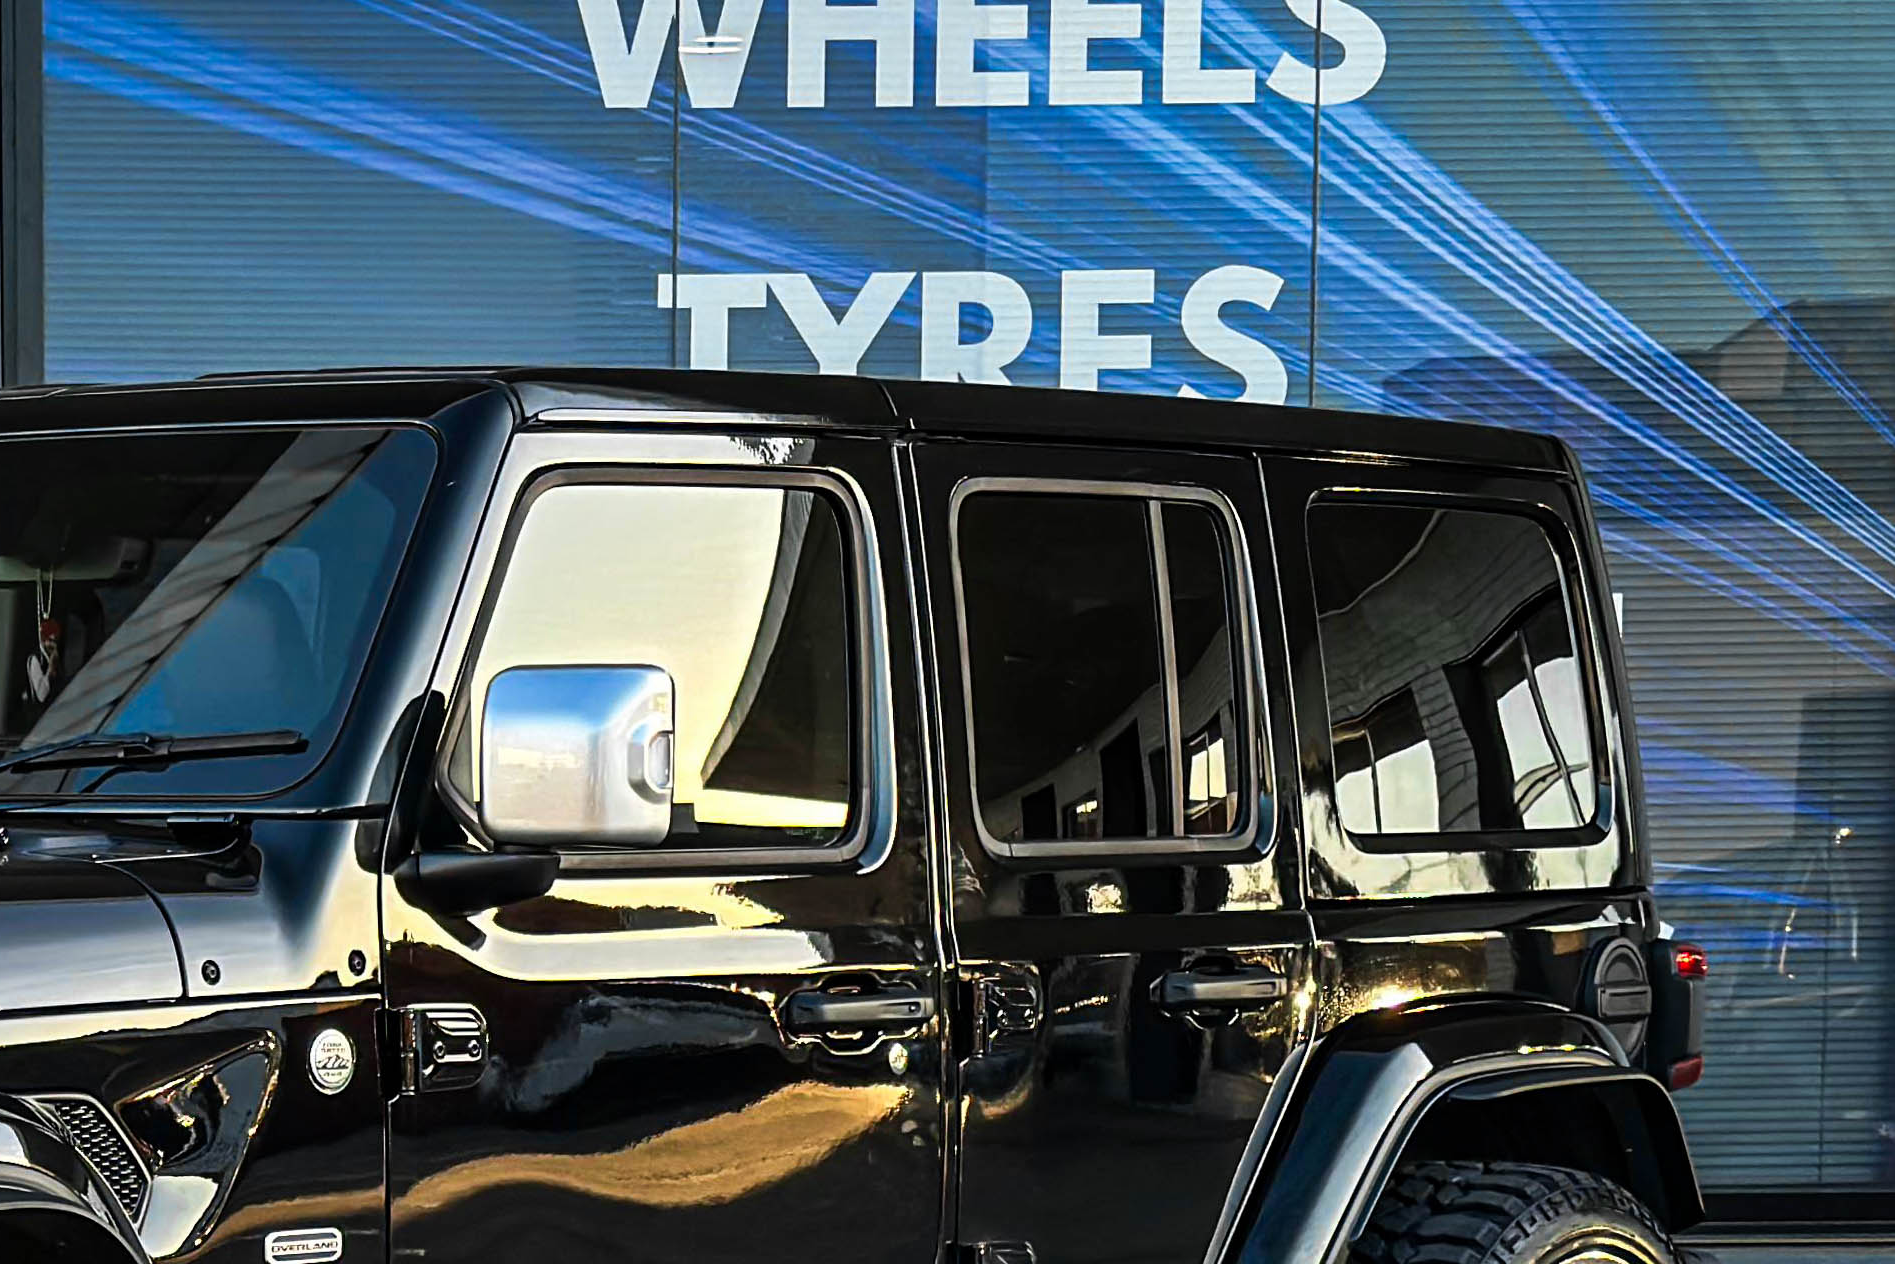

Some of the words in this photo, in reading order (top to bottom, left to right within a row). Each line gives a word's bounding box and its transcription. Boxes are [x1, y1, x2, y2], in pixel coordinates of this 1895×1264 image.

[581, 0, 1387, 108] WHEELS
[657, 264, 1288, 405] TYRES
[271, 1240, 339, 1253] OVERLAND
